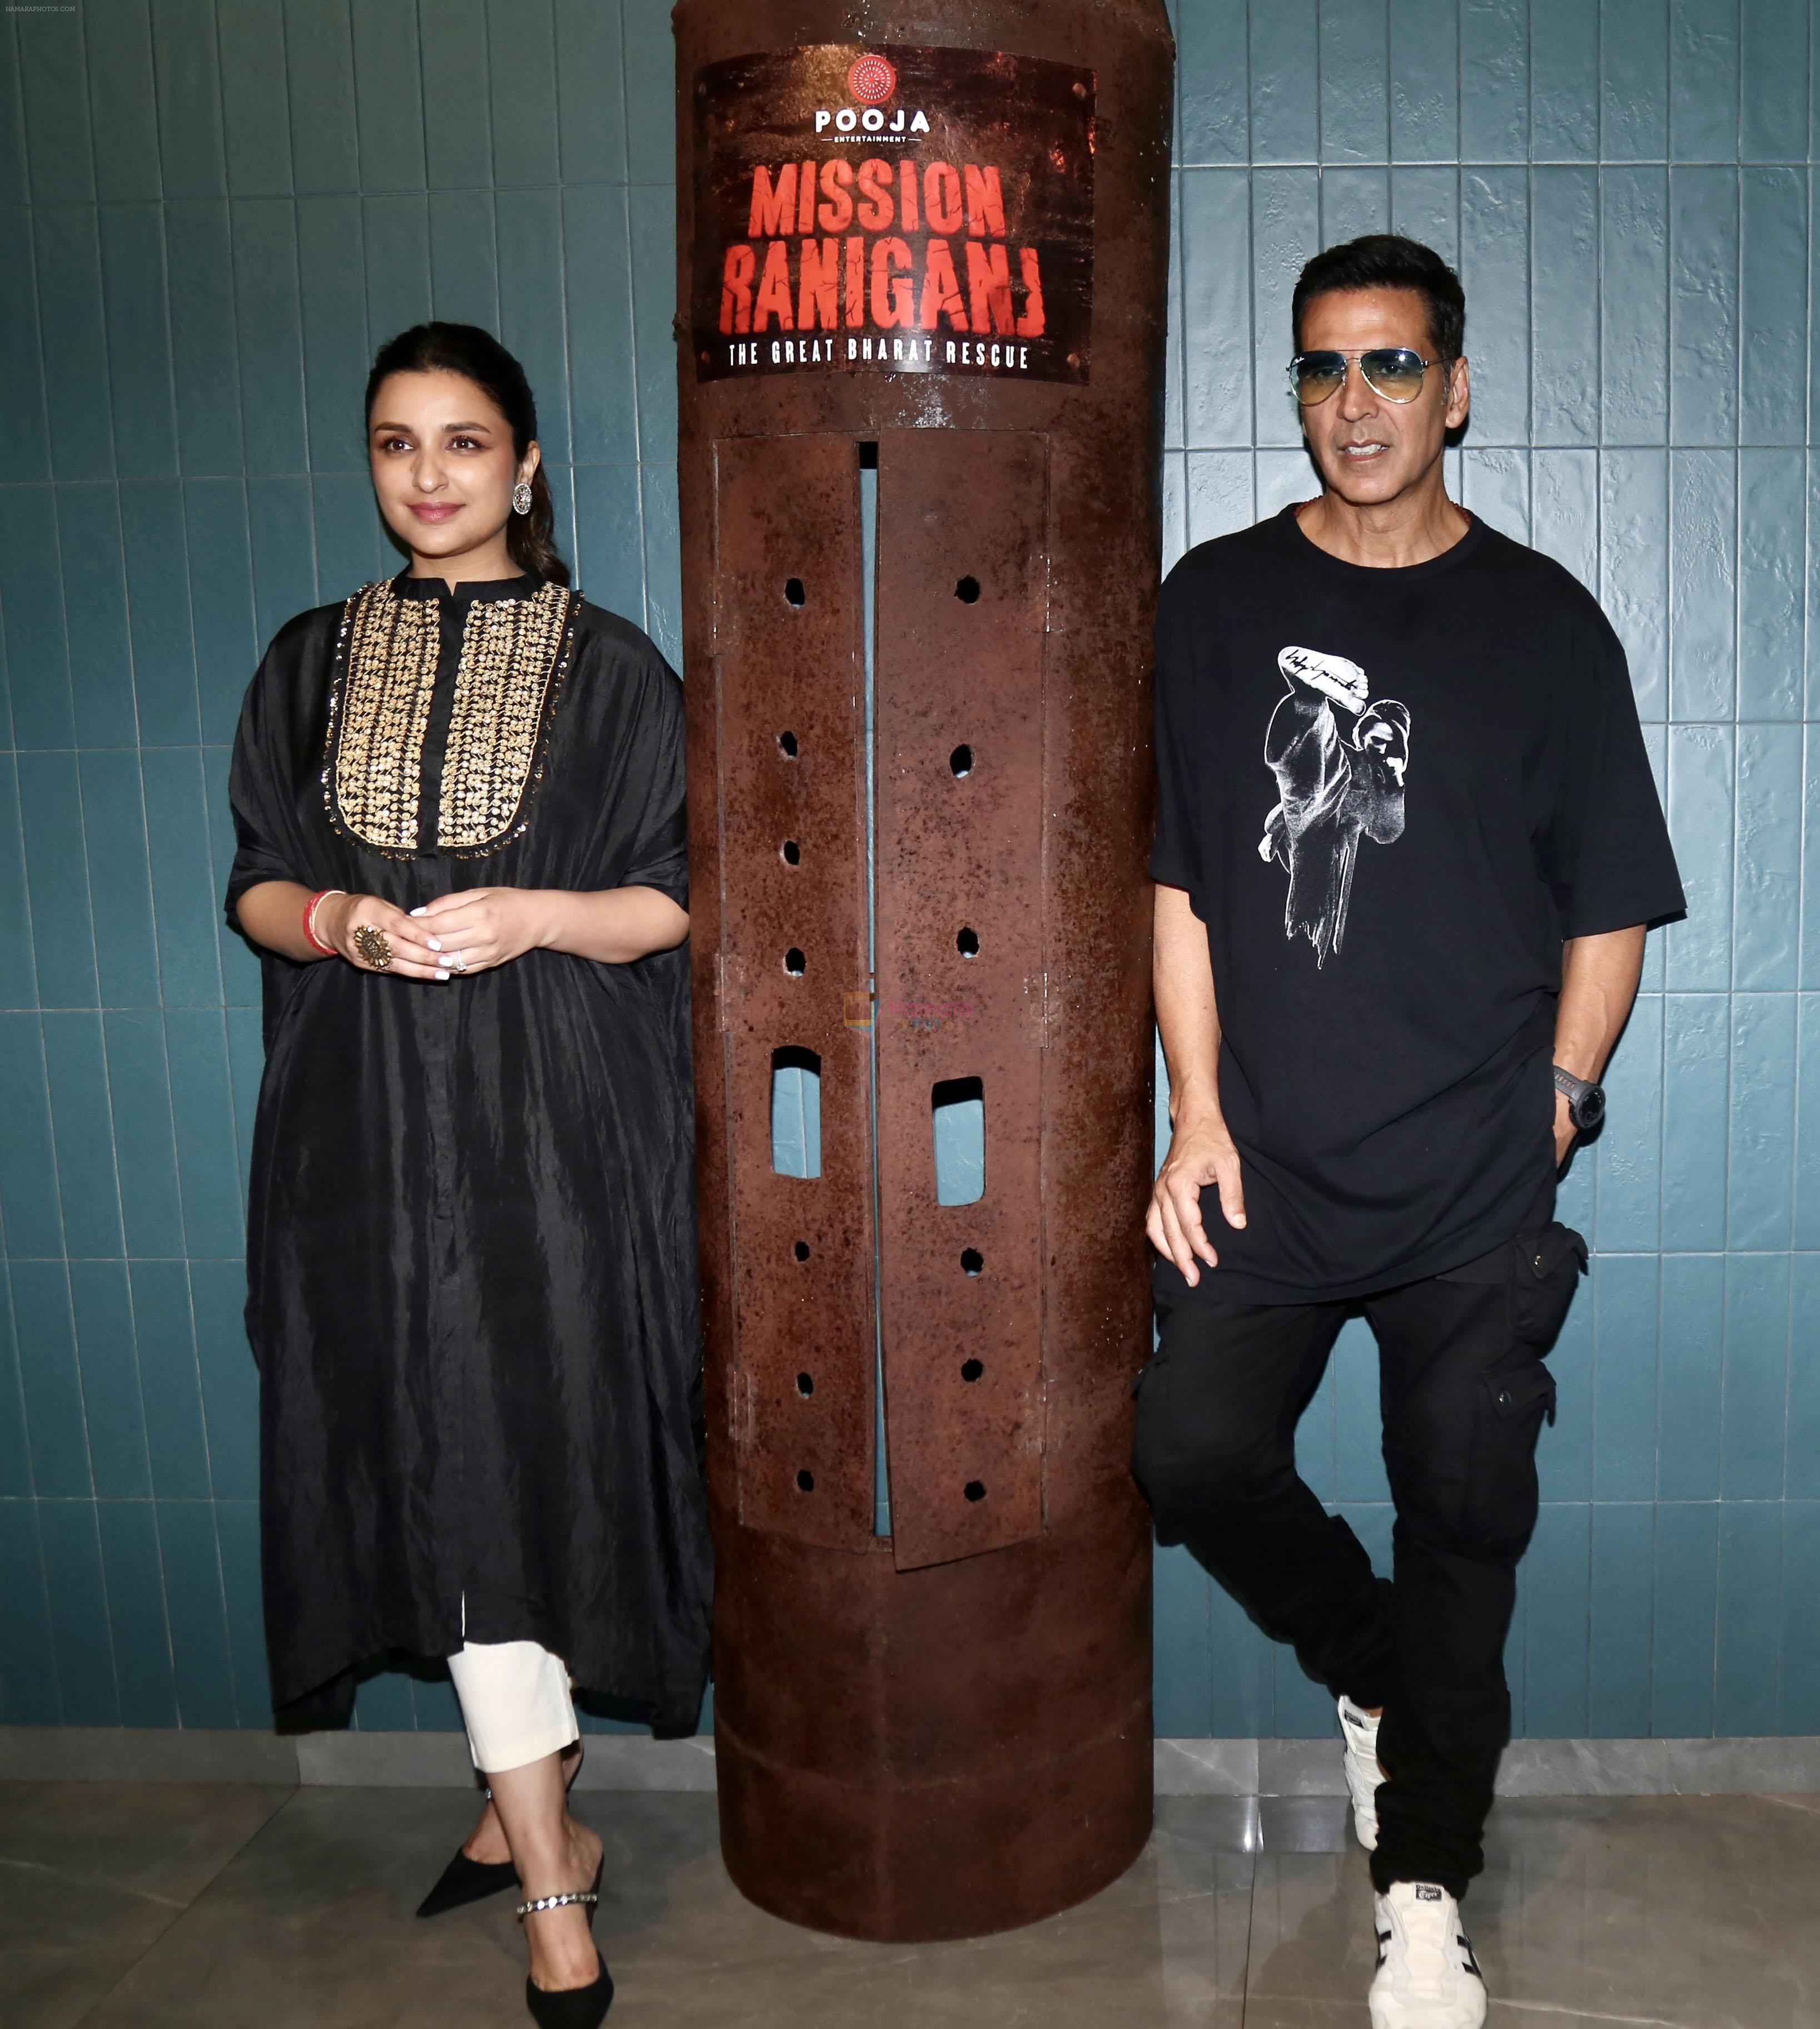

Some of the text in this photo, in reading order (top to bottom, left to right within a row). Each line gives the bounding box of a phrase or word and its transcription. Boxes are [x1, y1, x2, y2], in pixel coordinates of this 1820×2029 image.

[815, 108, 930, 133] POOJA
[747, 159, 1006, 238] MISSION
[718, 237, 1045, 339] RANIGANJ
[729, 338, 1028, 369] THE GREAT BHARAT RESCUE
